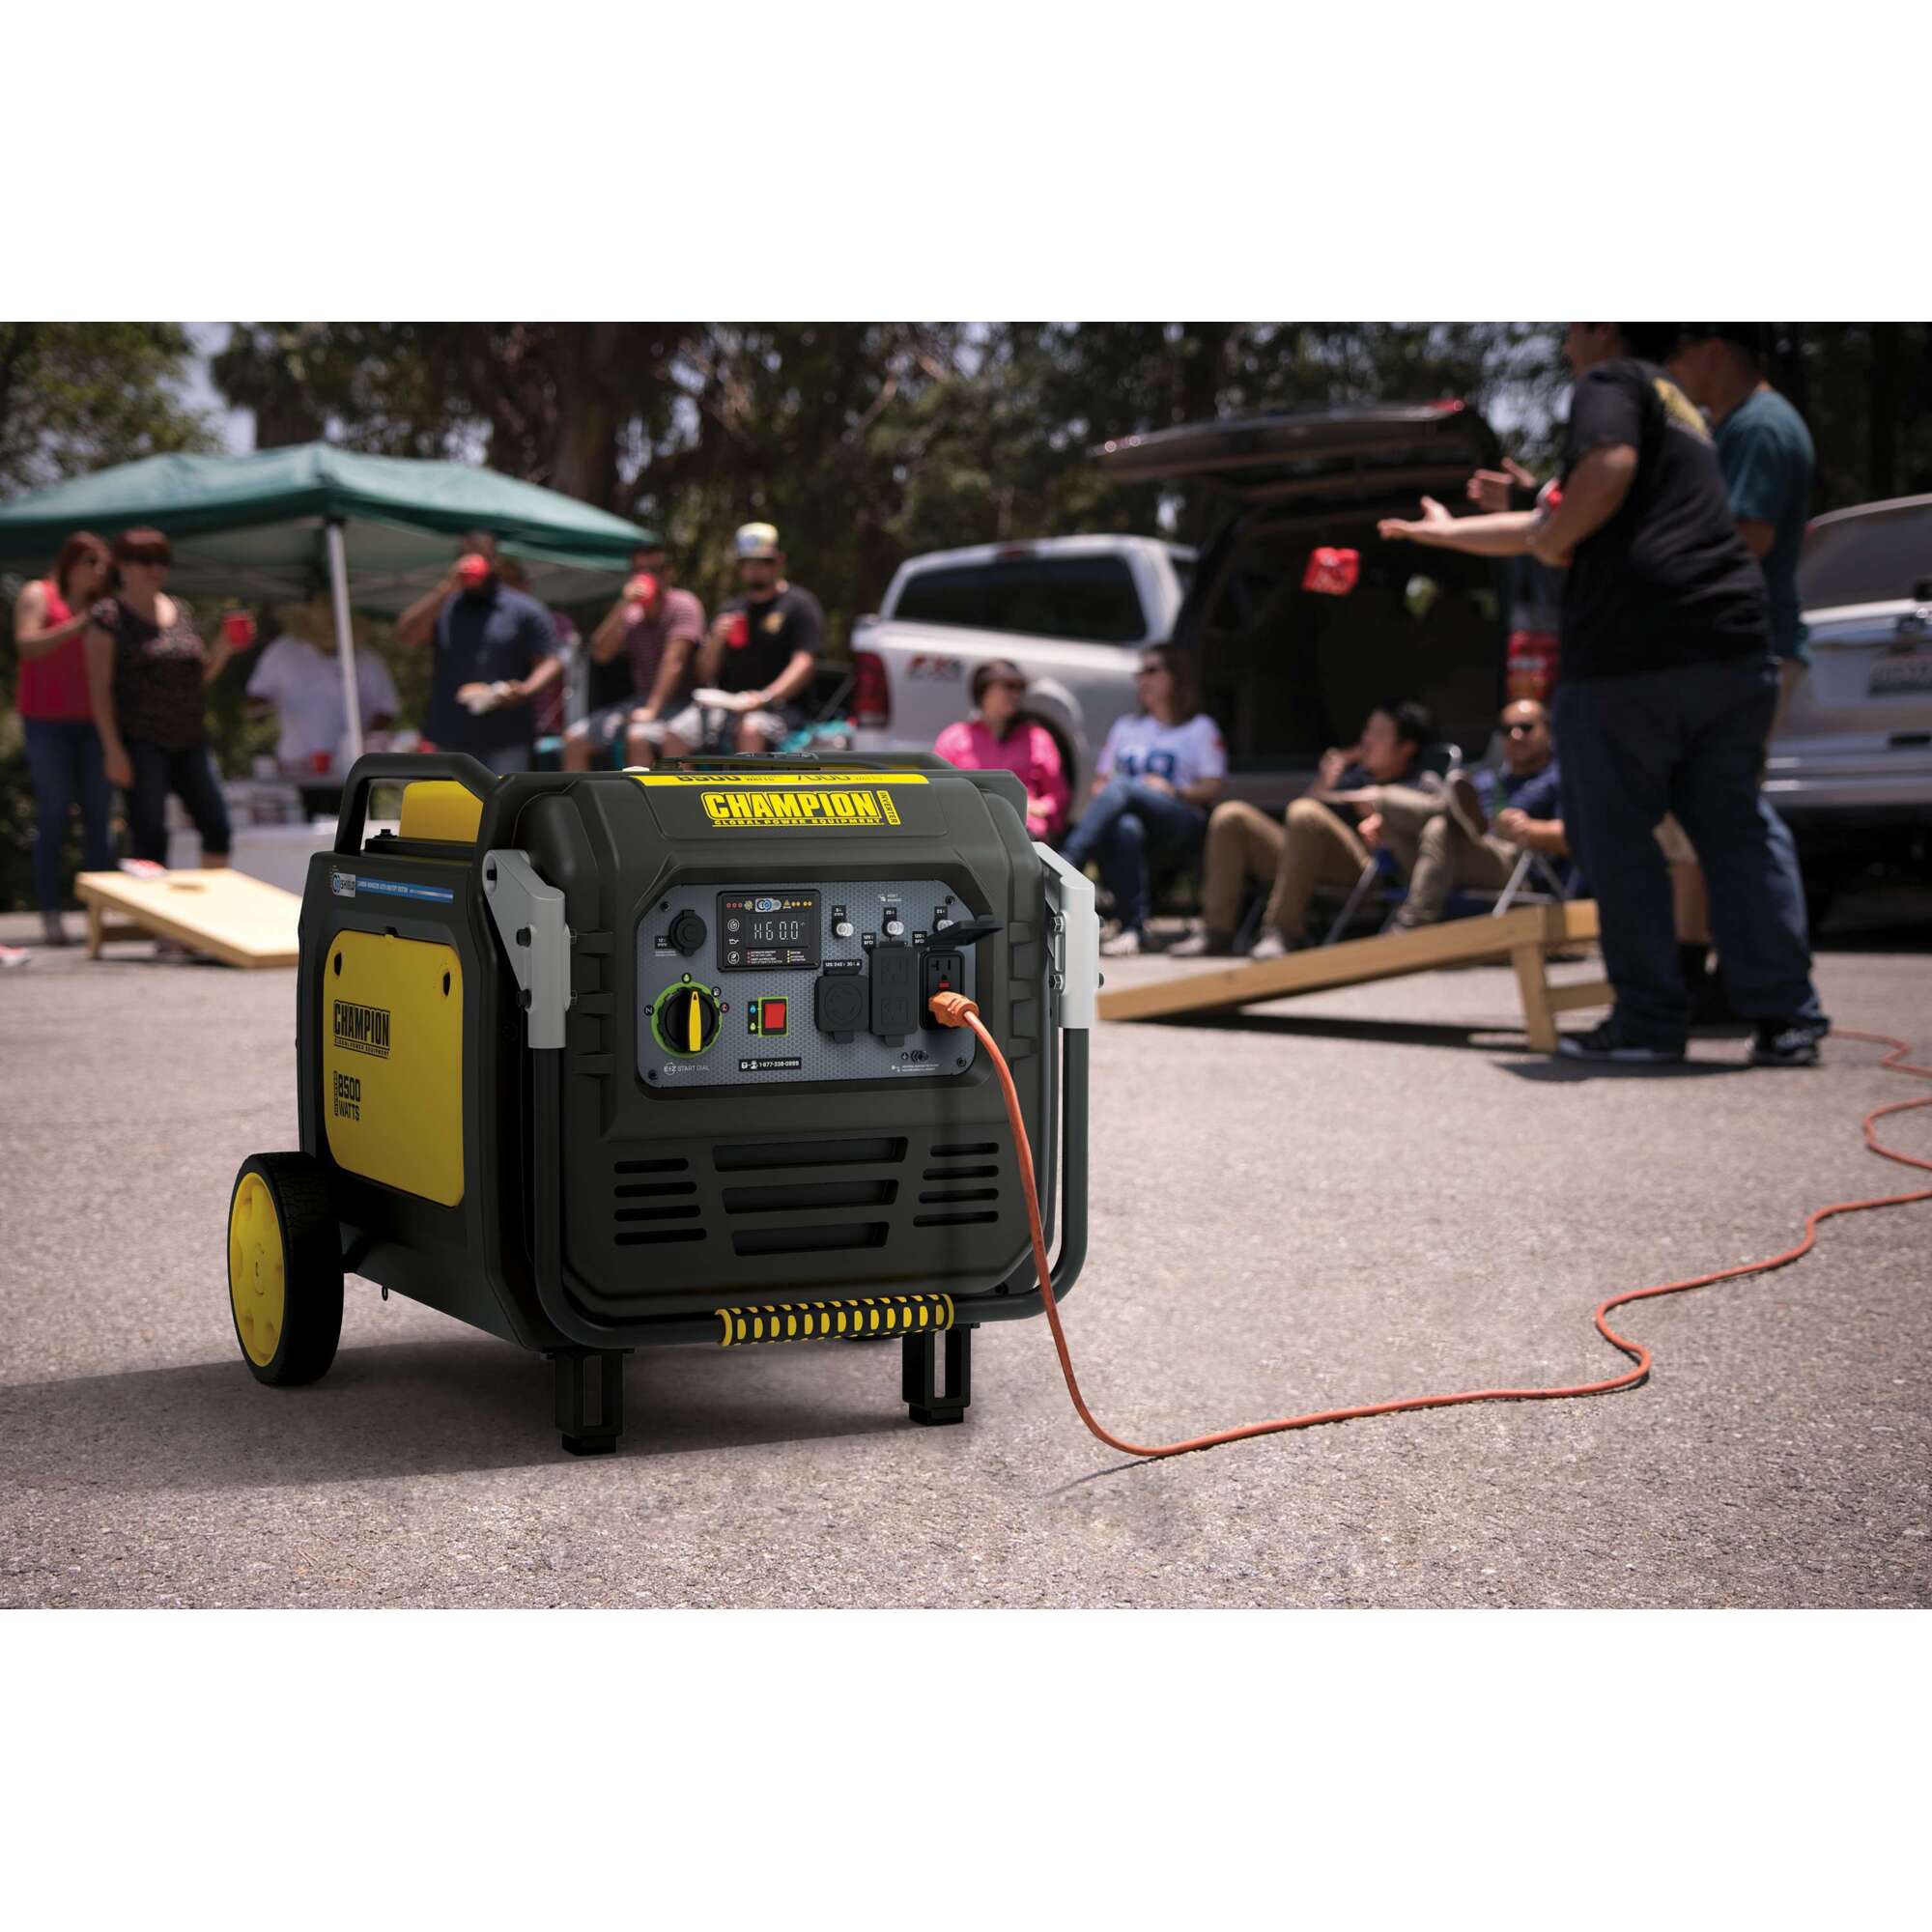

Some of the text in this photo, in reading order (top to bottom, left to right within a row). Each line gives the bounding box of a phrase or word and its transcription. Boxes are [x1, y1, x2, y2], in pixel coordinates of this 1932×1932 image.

[705, 793, 878, 818] CHAMPION
[879, 791, 898, 823] INVERTER
[334, 1004, 390, 1047] CHAMPION
[338, 1073, 360, 1102] 8500
[338, 1099, 359, 1121] WATTS
